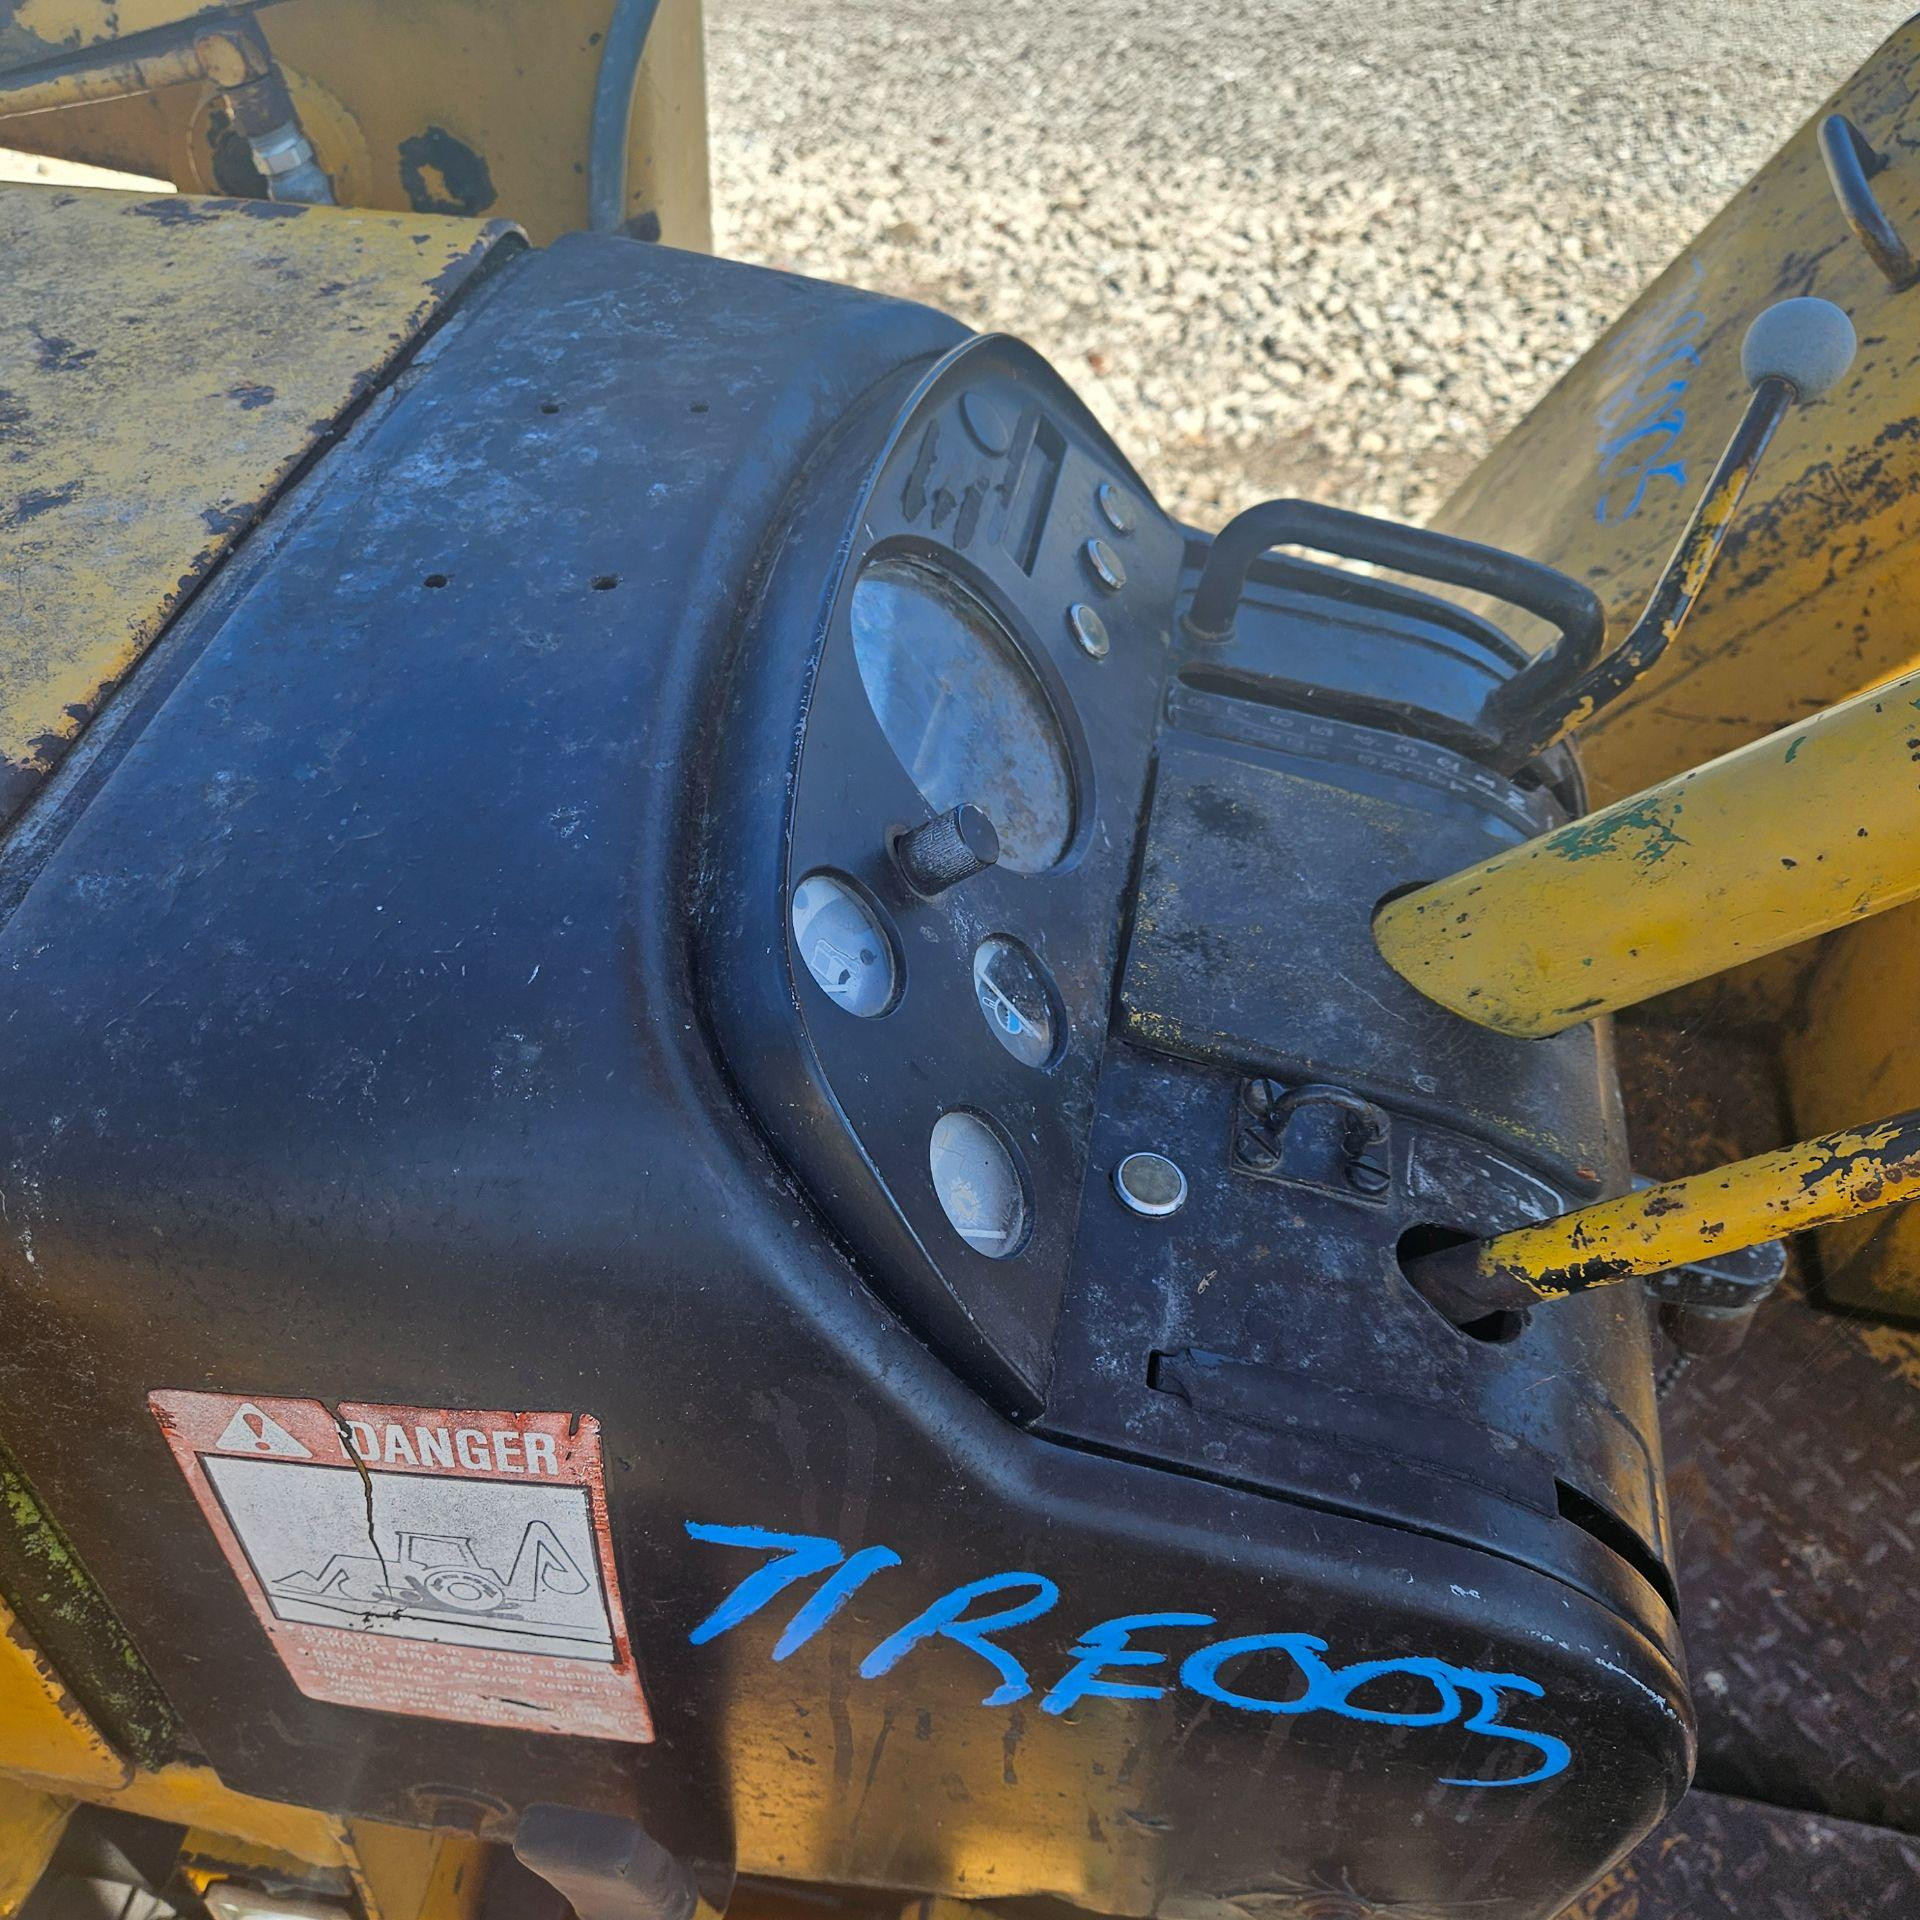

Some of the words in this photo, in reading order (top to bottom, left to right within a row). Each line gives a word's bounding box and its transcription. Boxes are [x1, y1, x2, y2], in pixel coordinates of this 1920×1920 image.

[1269, 714, 1294, 728] 6
[1310, 724, 1334, 738] 5
[1394, 744, 1419, 758] 3
[1436, 756, 1460, 774] 2
[335, 1420, 559, 1476] DANGER
